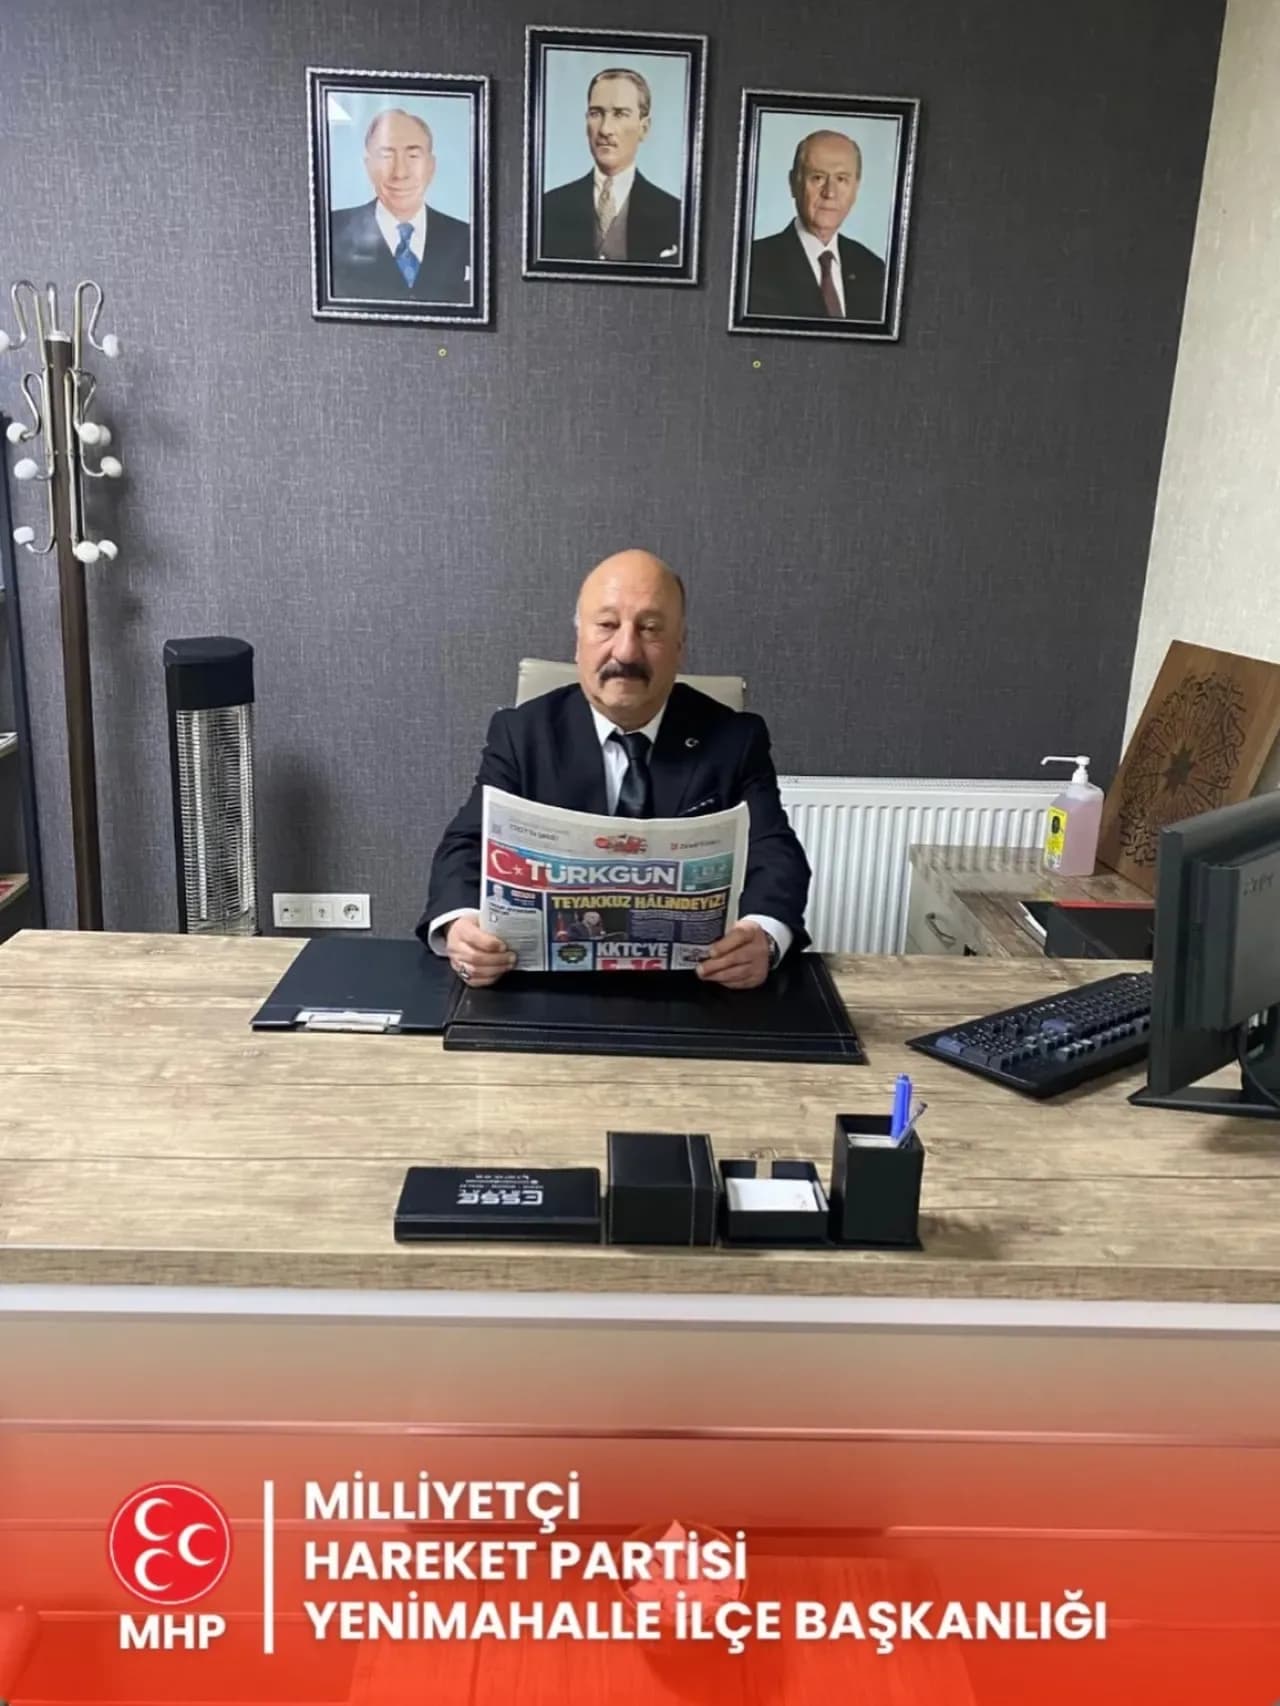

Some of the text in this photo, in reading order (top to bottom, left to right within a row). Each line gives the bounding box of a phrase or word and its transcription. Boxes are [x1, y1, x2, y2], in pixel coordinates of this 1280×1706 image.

[525, 858, 676, 885] TÜRKGÜN
[551, 895, 632, 909] TEYAKKUZ
[596, 942, 669, 957] KKTC'YE
